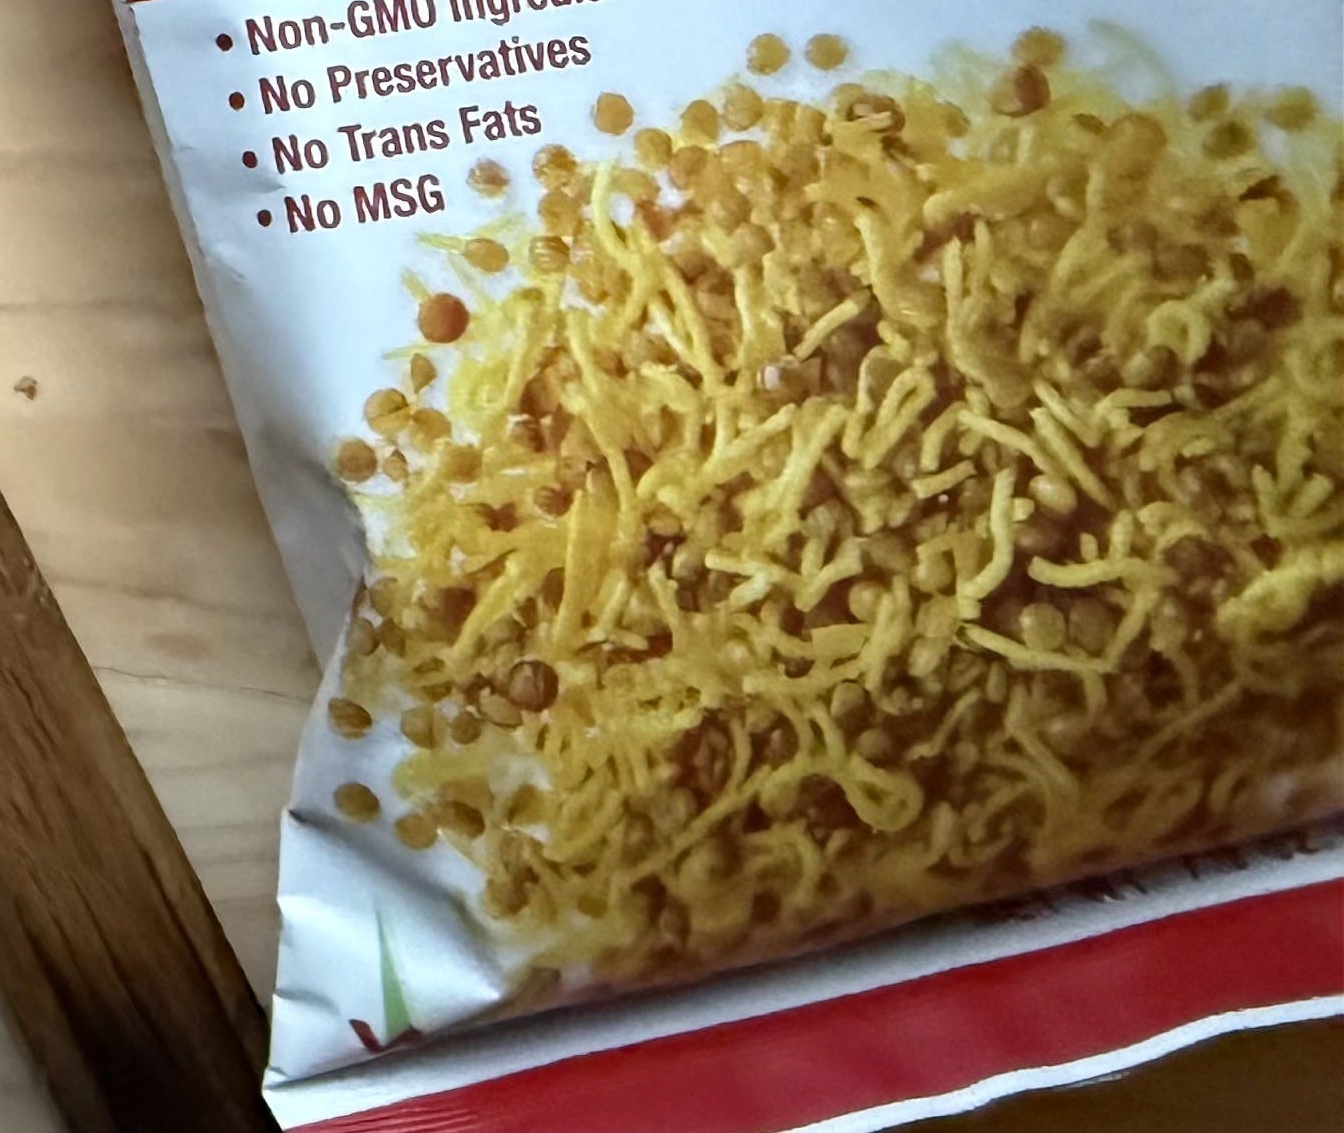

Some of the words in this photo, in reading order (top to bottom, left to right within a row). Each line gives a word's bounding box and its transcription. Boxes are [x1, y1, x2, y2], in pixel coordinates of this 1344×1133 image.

[258, 73, 316, 115] No
[325, 33, 593, 106] Preservatives
[271, 132, 330, 175] No
[336, 117, 452, 165] Trans
[457, 99, 544, 145] Fats
[284, 192, 343, 235] No
[351, 173, 446, 222] MSG
